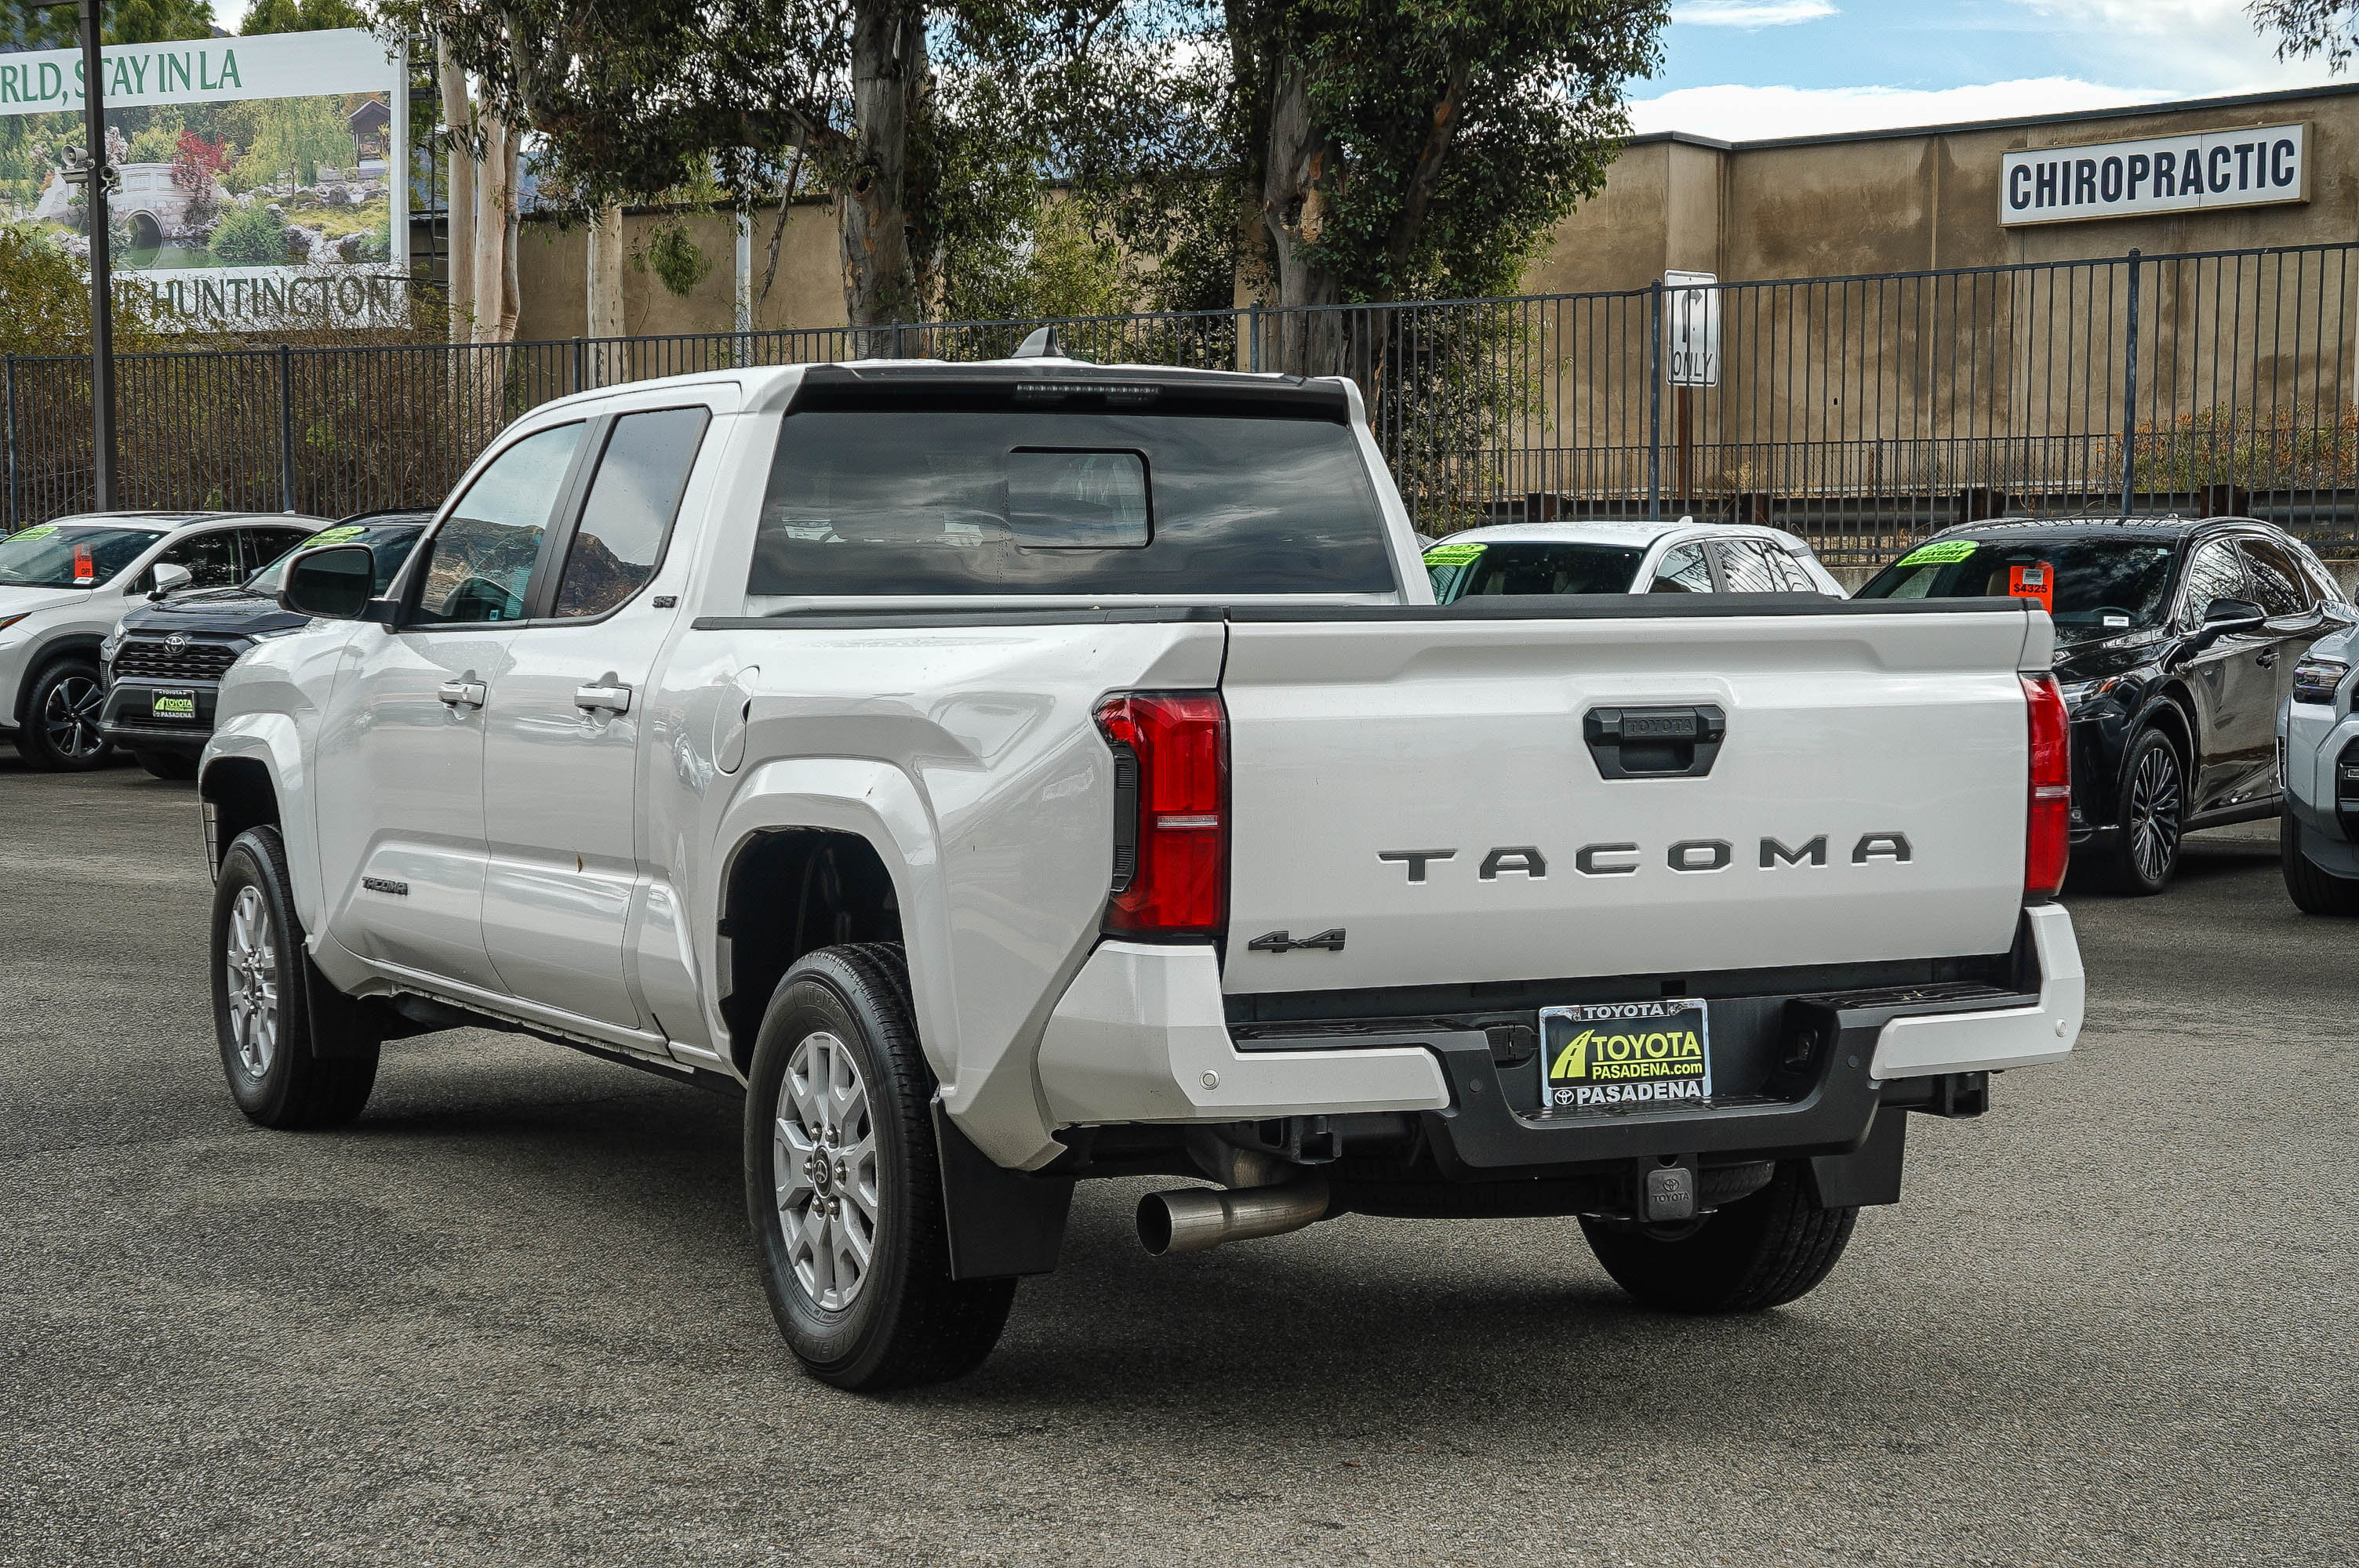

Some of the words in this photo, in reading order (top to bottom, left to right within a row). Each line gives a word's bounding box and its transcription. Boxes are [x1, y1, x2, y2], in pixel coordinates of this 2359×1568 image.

[158, 51, 191, 93] IN
[199, 49, 242, 90] LA
[2009, 139, 2295, 210] CHIROPRACTIC
[151, 275, 391, 317] HUNTINGTON
[1674, 350, 1713, 377] ONLY
[2014, 583, 2048, 593] $4325
[165, 698, 192, 708] TOYOTA
[1627, 718, 1694, 735] TOYOTA
[1378, 832, 1913, 884] TACOMA
[362, 876, 409, 896] TACOMA
[1583, 1004, 1664, 1019] TOYOTA
[1590, 1031, 1702, 1061] TOYOTA
[1592, 1062, 1703, 1080] PASADENA.com
[1576, 1080, 1702, 1105] PASADENA
[1652, 1192, 1689, 1203] TOYOTA
